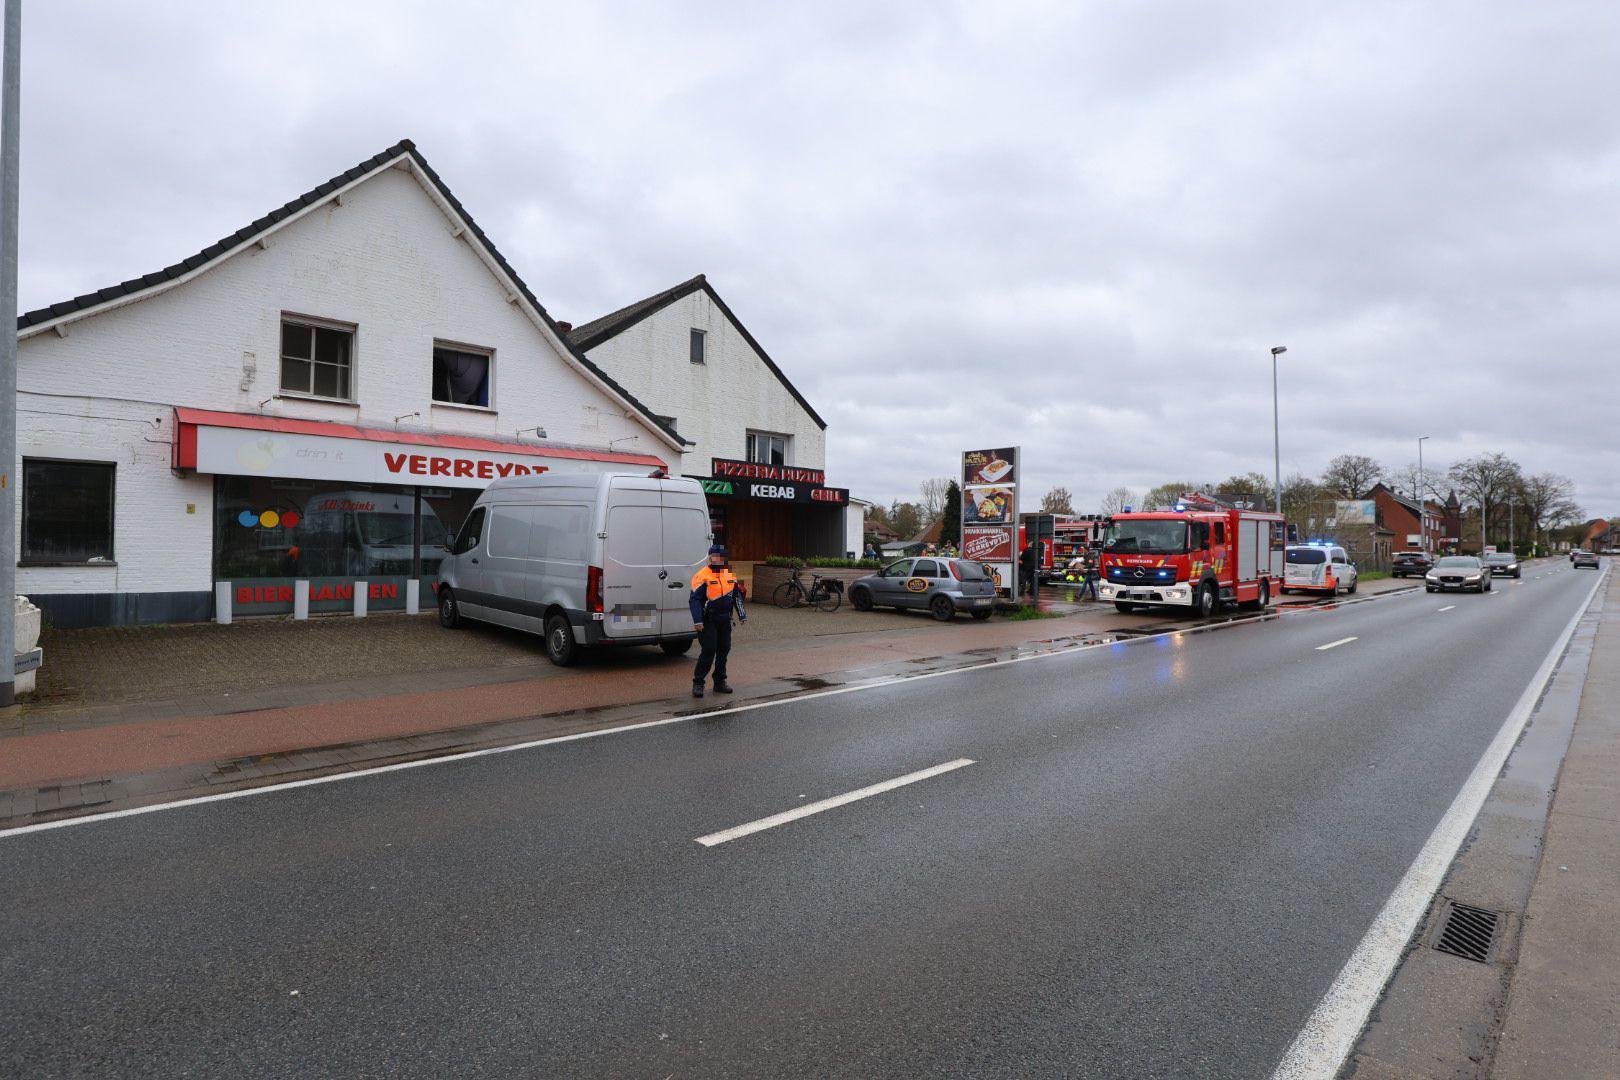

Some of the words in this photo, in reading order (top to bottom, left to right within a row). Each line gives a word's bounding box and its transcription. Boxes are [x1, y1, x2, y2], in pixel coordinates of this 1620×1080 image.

[384, 452, 549, 480] VERREYDT
[714, 460, 779, 481] PIZZERIA
[781, 467, 826, 484] HUZUR
[699, 480, 733, 495] IZZA
[750, 484, 795, 500] KEBAB
[811, 488, 843, 502] GRILL
